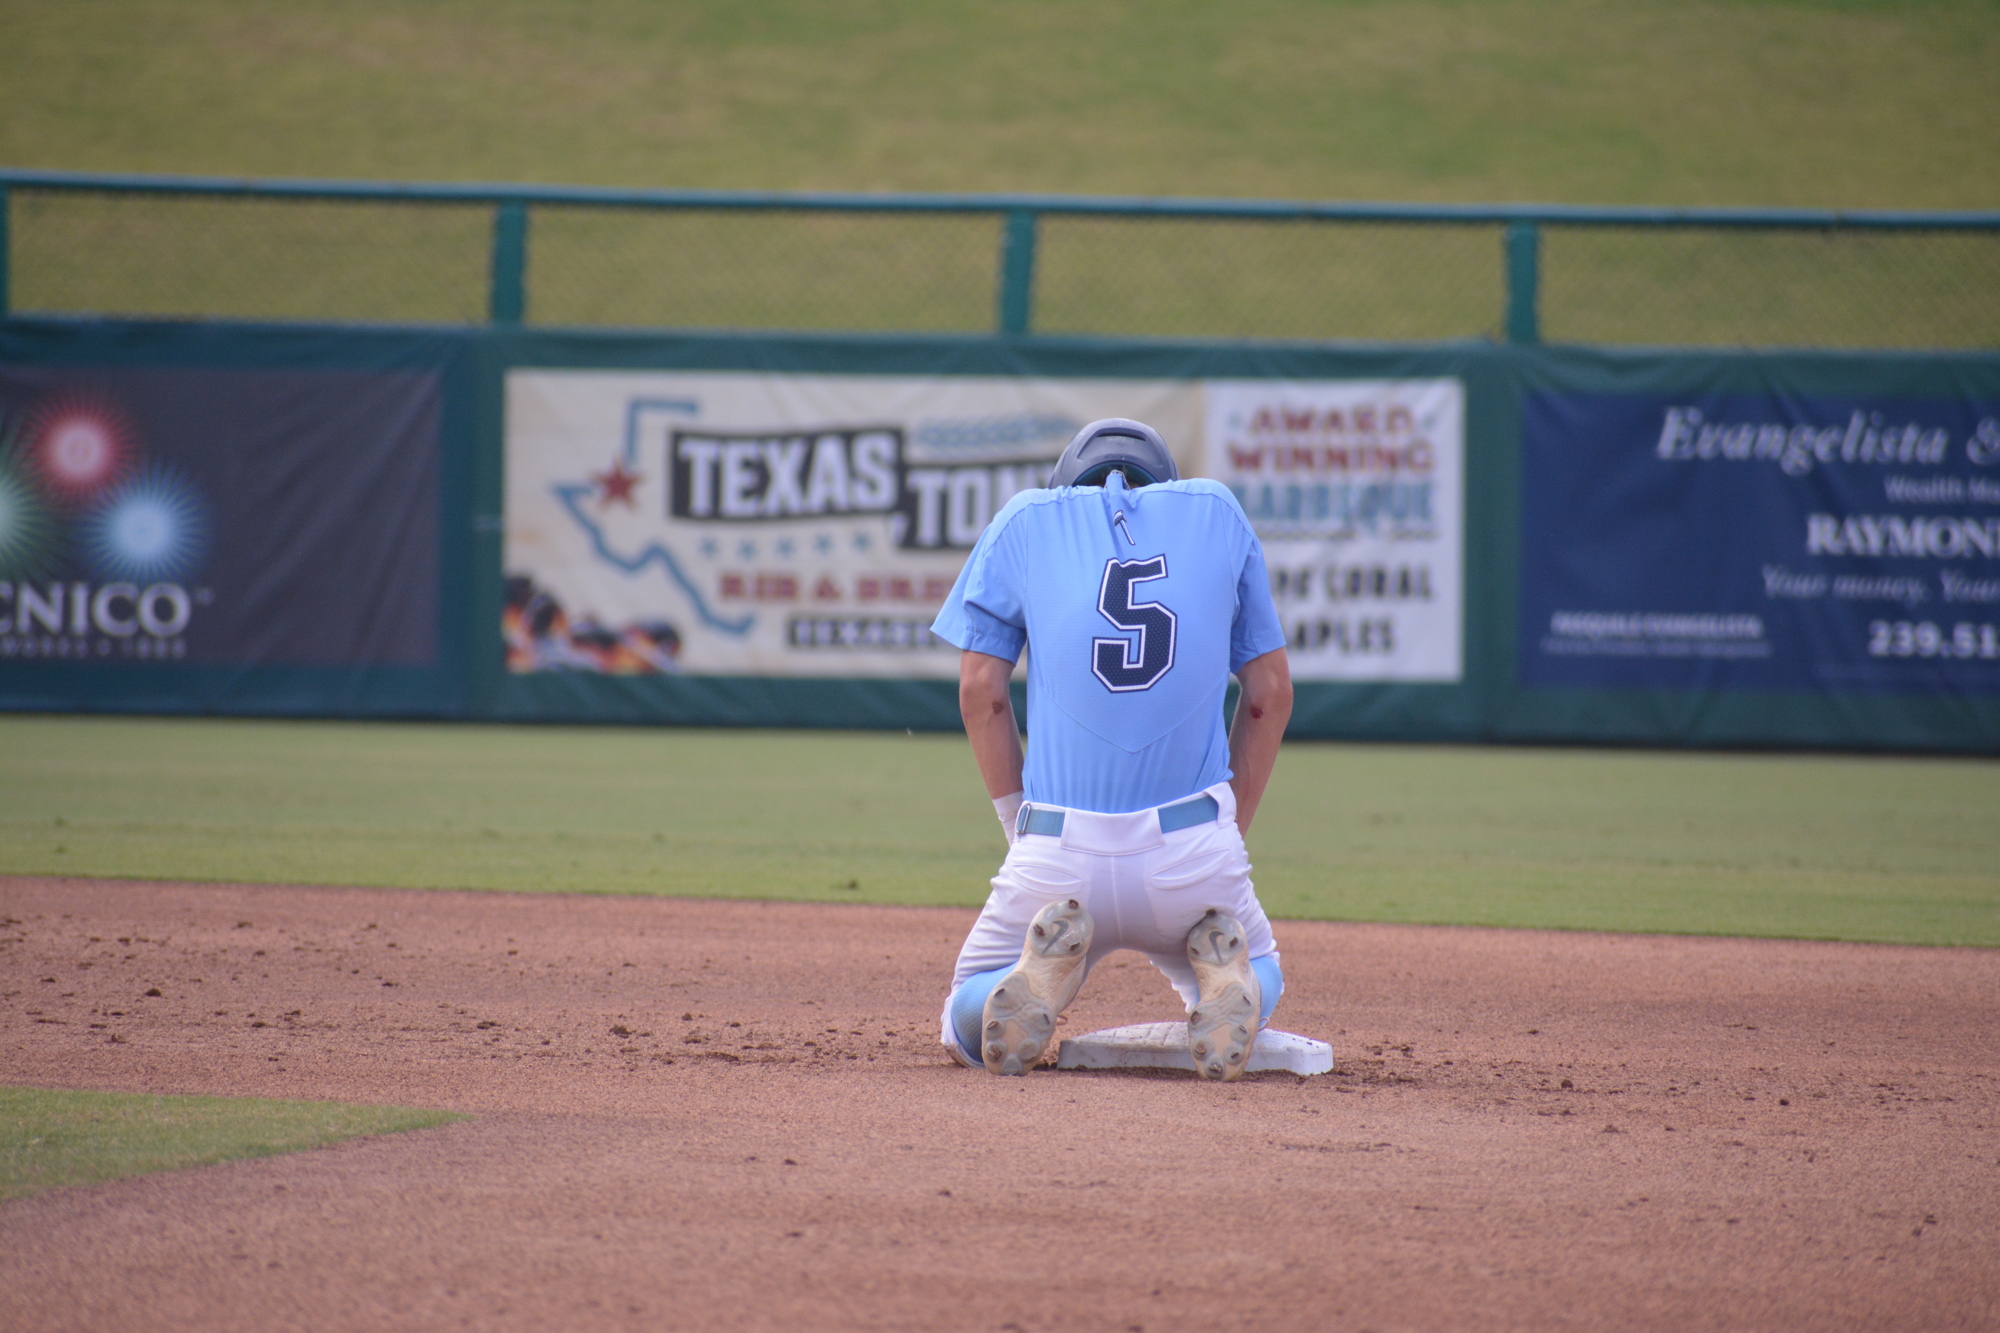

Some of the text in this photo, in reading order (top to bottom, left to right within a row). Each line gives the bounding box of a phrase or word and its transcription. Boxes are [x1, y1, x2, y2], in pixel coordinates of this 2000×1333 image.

[1249, 405, 1414, 434] AWARD
[1227, 440, 1433, 472] WINNING
[1656, 406, 2000, 476] Evangelista &
[680, 435, 897, 516] TEXAS
[906, 464, 1053, 547] TO
[1806, 513, 2000, 557] RAYMON
[857, 577, 957, 600] BRE
[1276, 566, 1433, 598] PE CORAL
[0, 582, 191, 636] NICO
[1091, 554, 1178, 693] 5
[1287, 618, 1394, 650] APLES
[1868, 619, 1998, 659] 239.51
